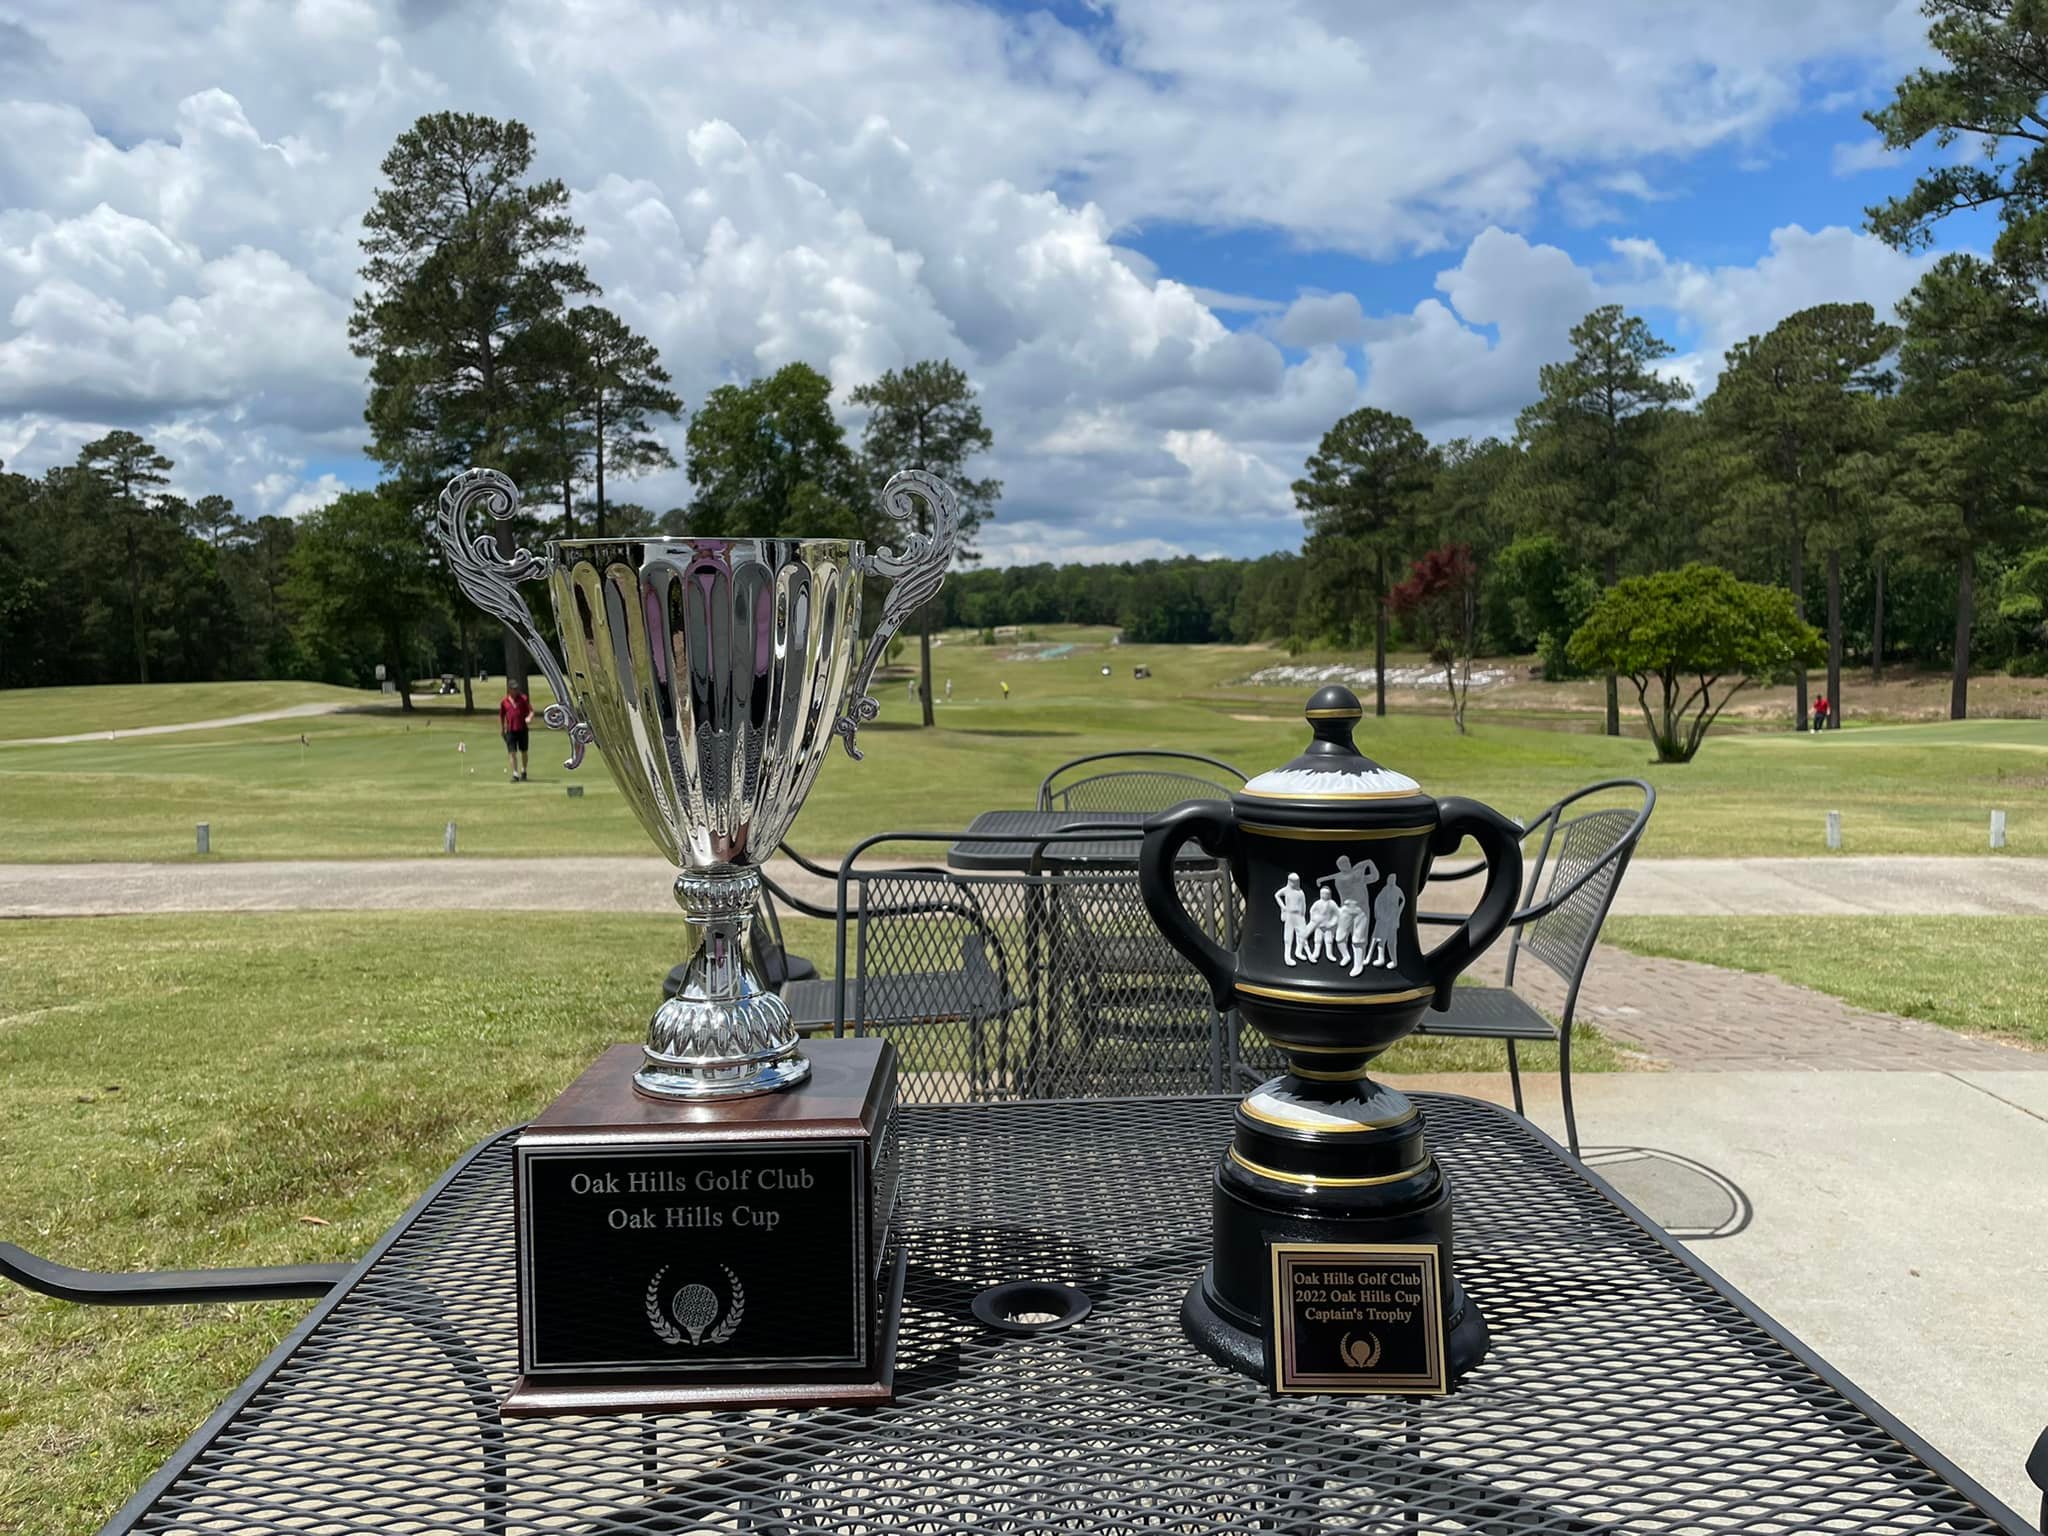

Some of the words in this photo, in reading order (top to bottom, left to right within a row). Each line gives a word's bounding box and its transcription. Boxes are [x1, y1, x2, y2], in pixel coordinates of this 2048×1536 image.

[570, 1172, 621, 1194] Oak
[627, 1171, 687, 1193] Hills
[695, 1169, 752, 1192] Golf
[757, 1168, 815, 1190] Club
[608, 1208, 657, 1230] Oak
[665, 1206, 723, 1228] Hills
[731, 1205, 780, 1231] Cup
[1294, 1272, 1320, 1285] Oak
[1323, 1272, 1354, 1285] Hills
[1358, 1273, 1387, 1286] Golf
[1390, 1273, 1421, 1286] Club
[1295, 1290, 1327, 1303] 2022
[1330, 1290, 1356, 1303] Oak
[1360, 1290, 1391, 1303] Hills
[1394, 1290, 1421, 1306] Cup
[1305, 1307, 1363, 1323] Captain's
[1366, 1308, 1412, 1323] Trophy
